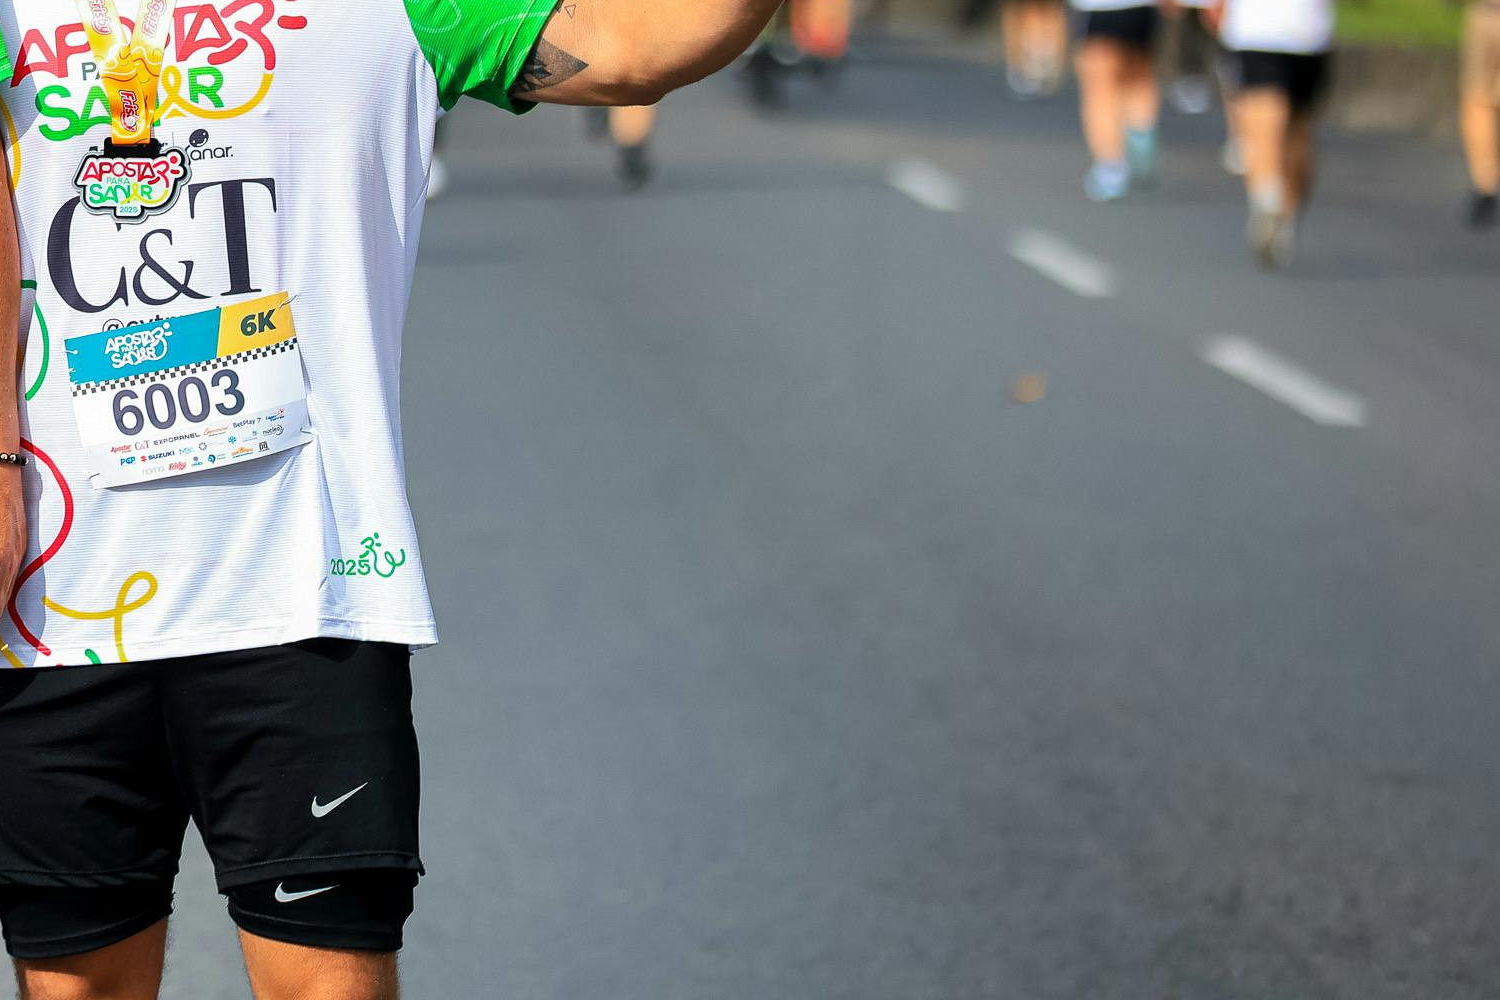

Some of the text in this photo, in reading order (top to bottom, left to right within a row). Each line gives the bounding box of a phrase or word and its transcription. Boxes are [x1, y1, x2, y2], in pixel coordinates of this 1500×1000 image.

[118, 89, 140, 132] Frisy
[82, 160, 170, 188] APOSTAR
[106, 177, 131, 185] PARA
[47, 178, 277, 313] C&T
[240, 308, 277, 337] 6K
[105, 325, 169, 354] APOSTAR
[112, 369, 245, 436] 6003
[153, 432, 201, 446] EXPOPANEL
[148, 450, 175, 460] SUZUKI
[330, 558, 370, 576] 2025
